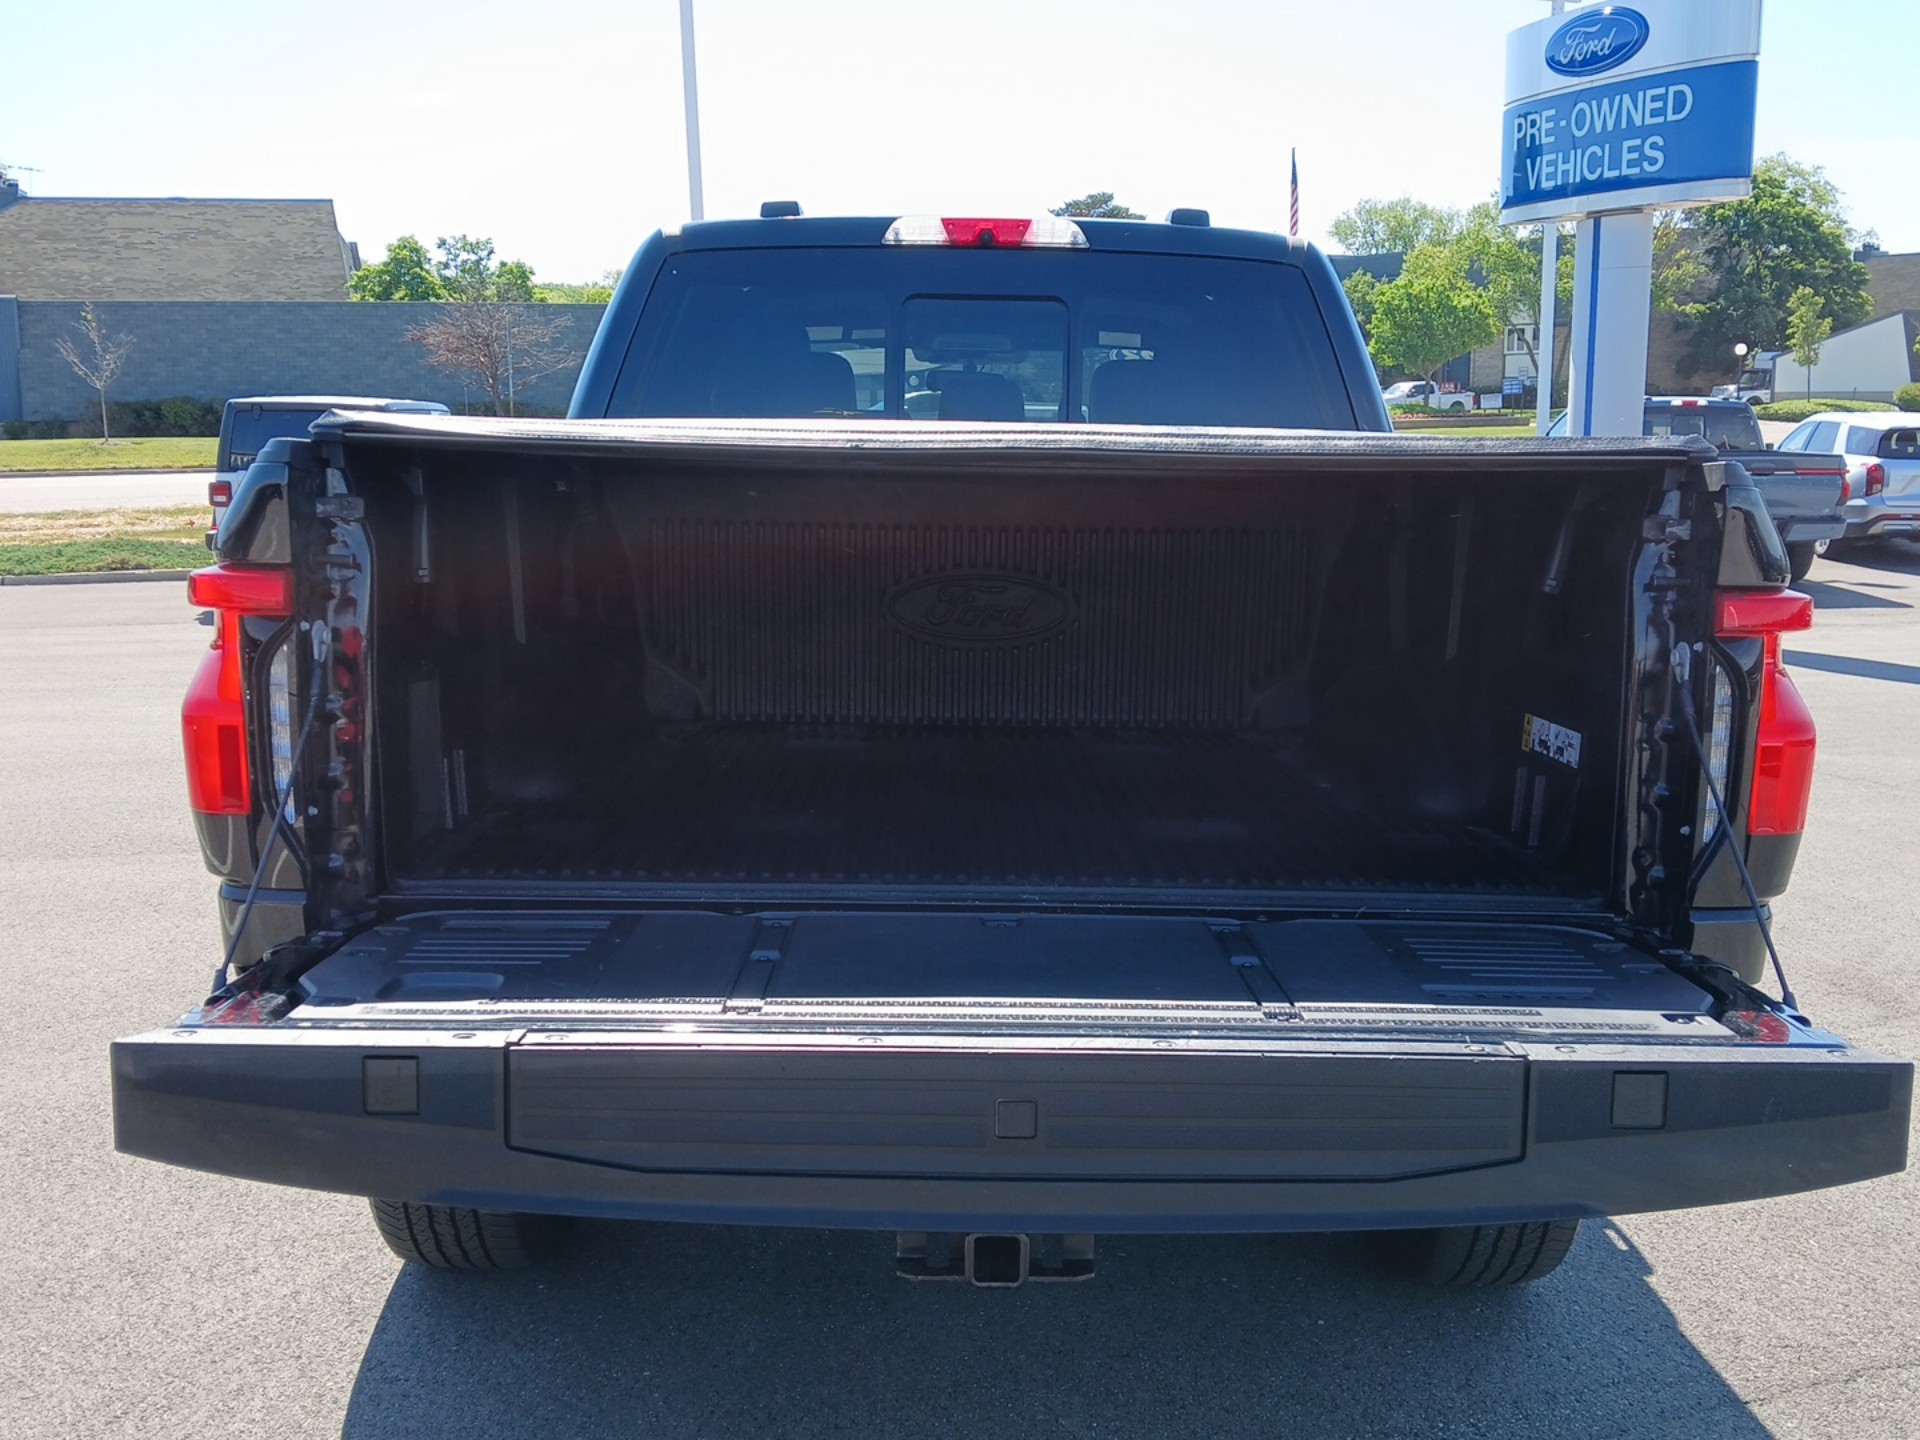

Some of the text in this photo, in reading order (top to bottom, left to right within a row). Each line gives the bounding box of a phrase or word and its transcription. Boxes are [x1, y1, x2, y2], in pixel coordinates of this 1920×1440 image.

[1560, 23, 1616, 64] Ford
[1514, 84, 1693, 149] PRE-OWNED
[1526, 135, 1665, 190] VEHICLES
[927, 583, 1031, 627] Ford
